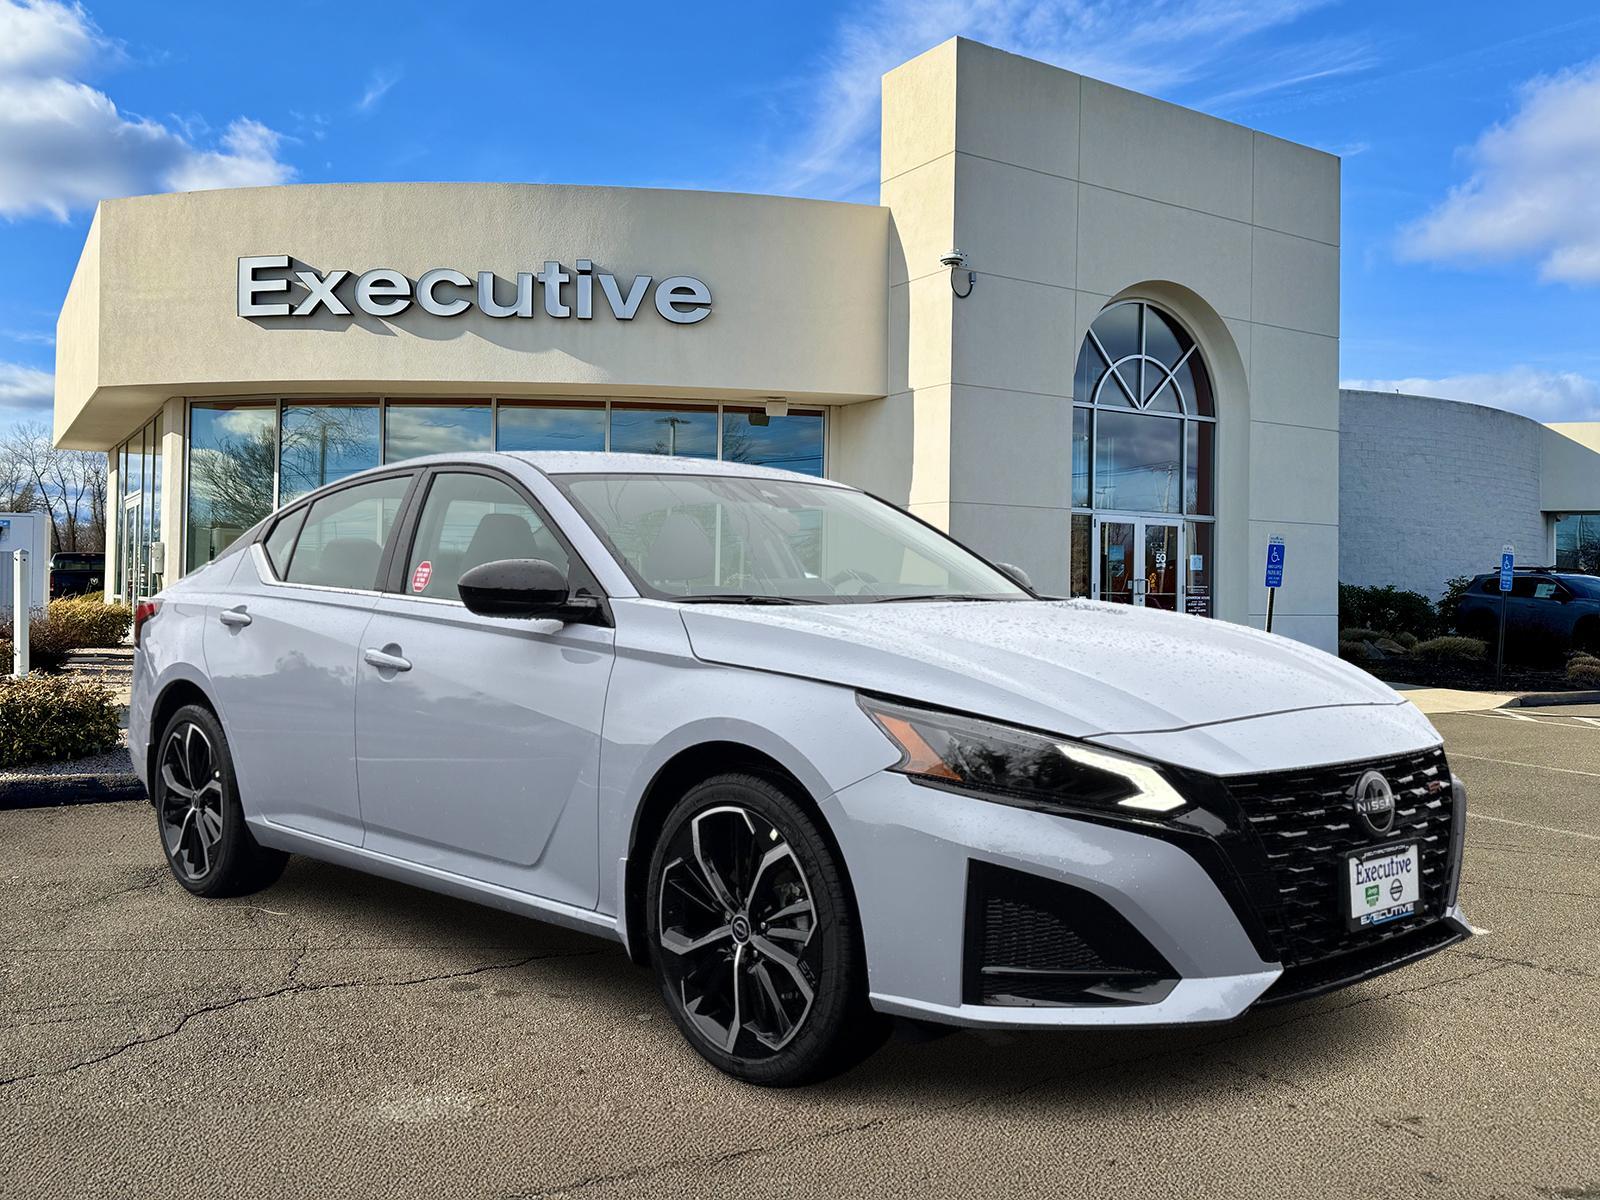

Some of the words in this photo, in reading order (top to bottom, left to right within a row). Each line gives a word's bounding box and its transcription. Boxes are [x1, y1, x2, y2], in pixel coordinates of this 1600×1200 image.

[237, 255, 713, 325] Executive
[1355, 856, 1411, 885] Executive
[1360, 902, 1414, 925] EXECUTIVE
